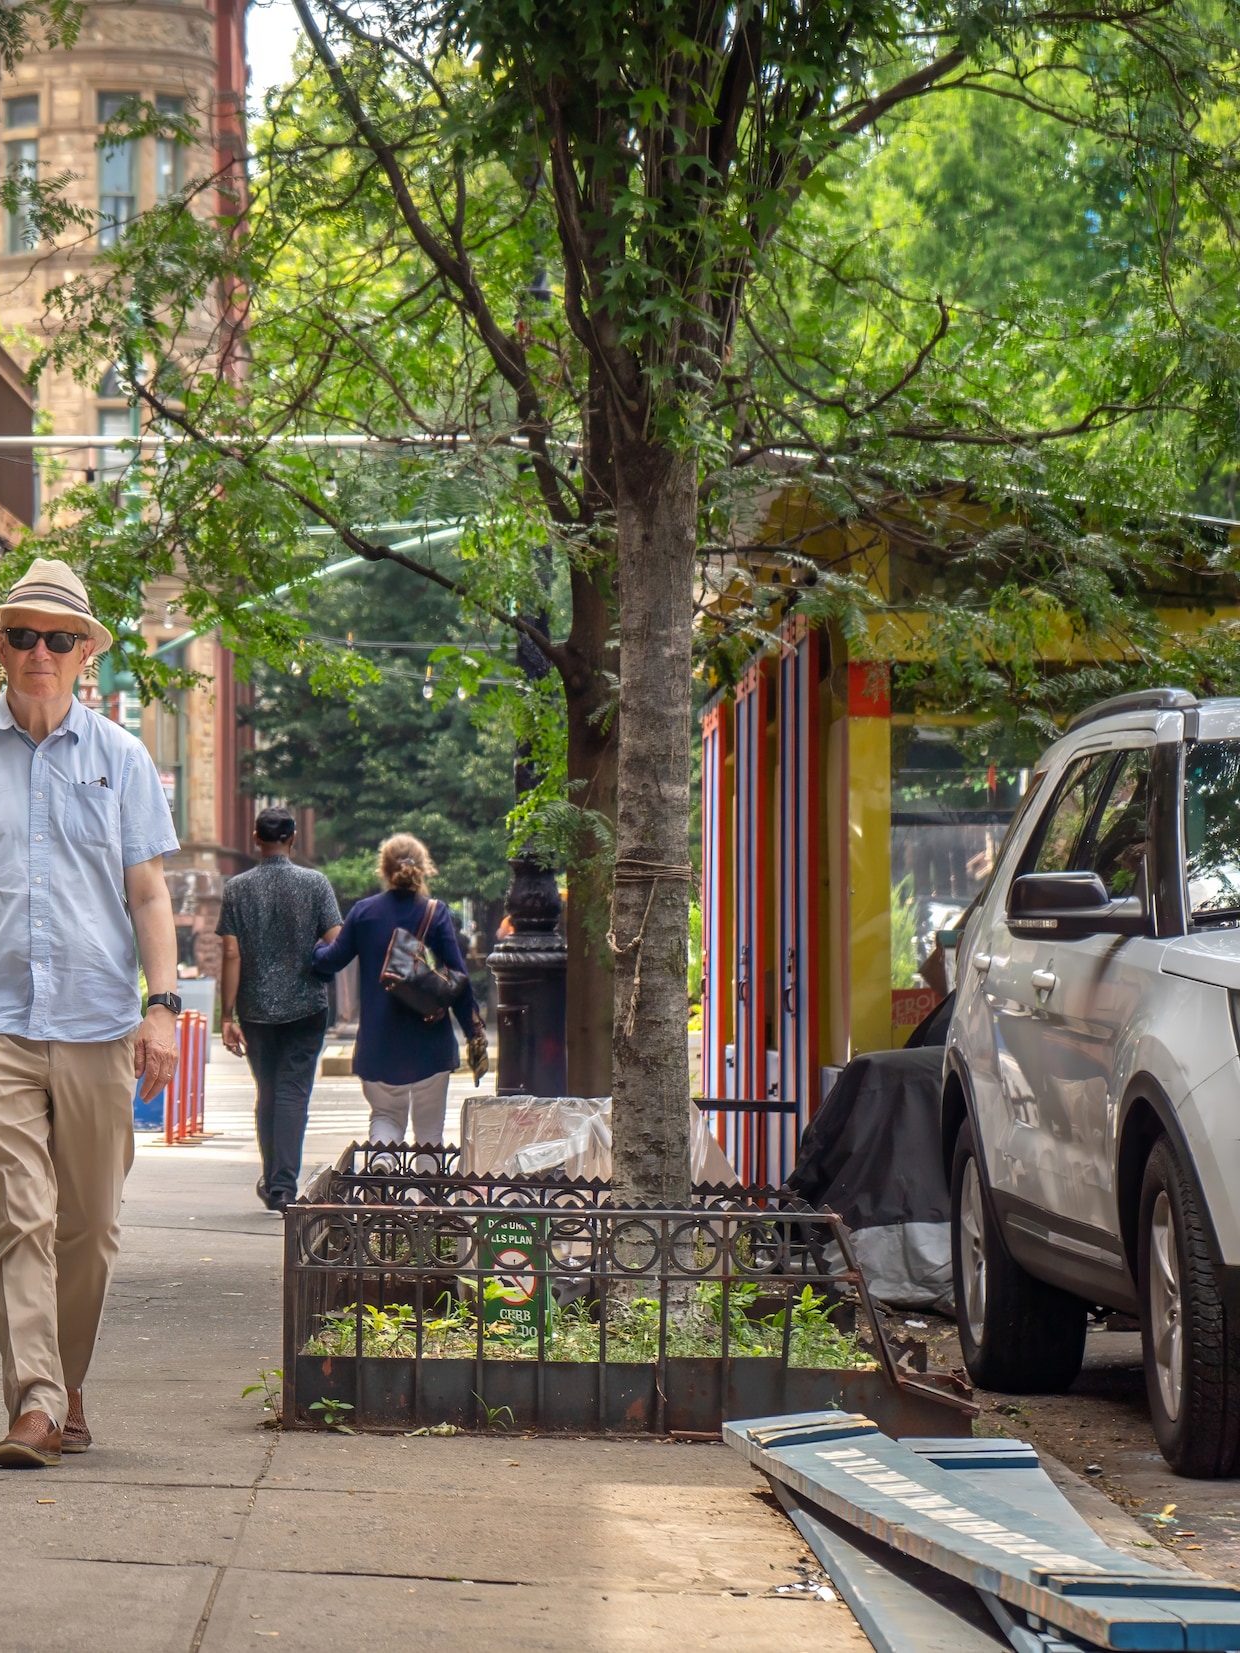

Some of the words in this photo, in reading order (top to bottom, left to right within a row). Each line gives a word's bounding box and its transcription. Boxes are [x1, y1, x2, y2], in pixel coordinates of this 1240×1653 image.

[488, 1219, 508, 1229] DG
[509, 1221, 537, 1230] URE
[483, 1233, 507, 1243] LLS
[509, 1234, 532, 1245] PLAN
[520, 1325, 538, 1338] DO
